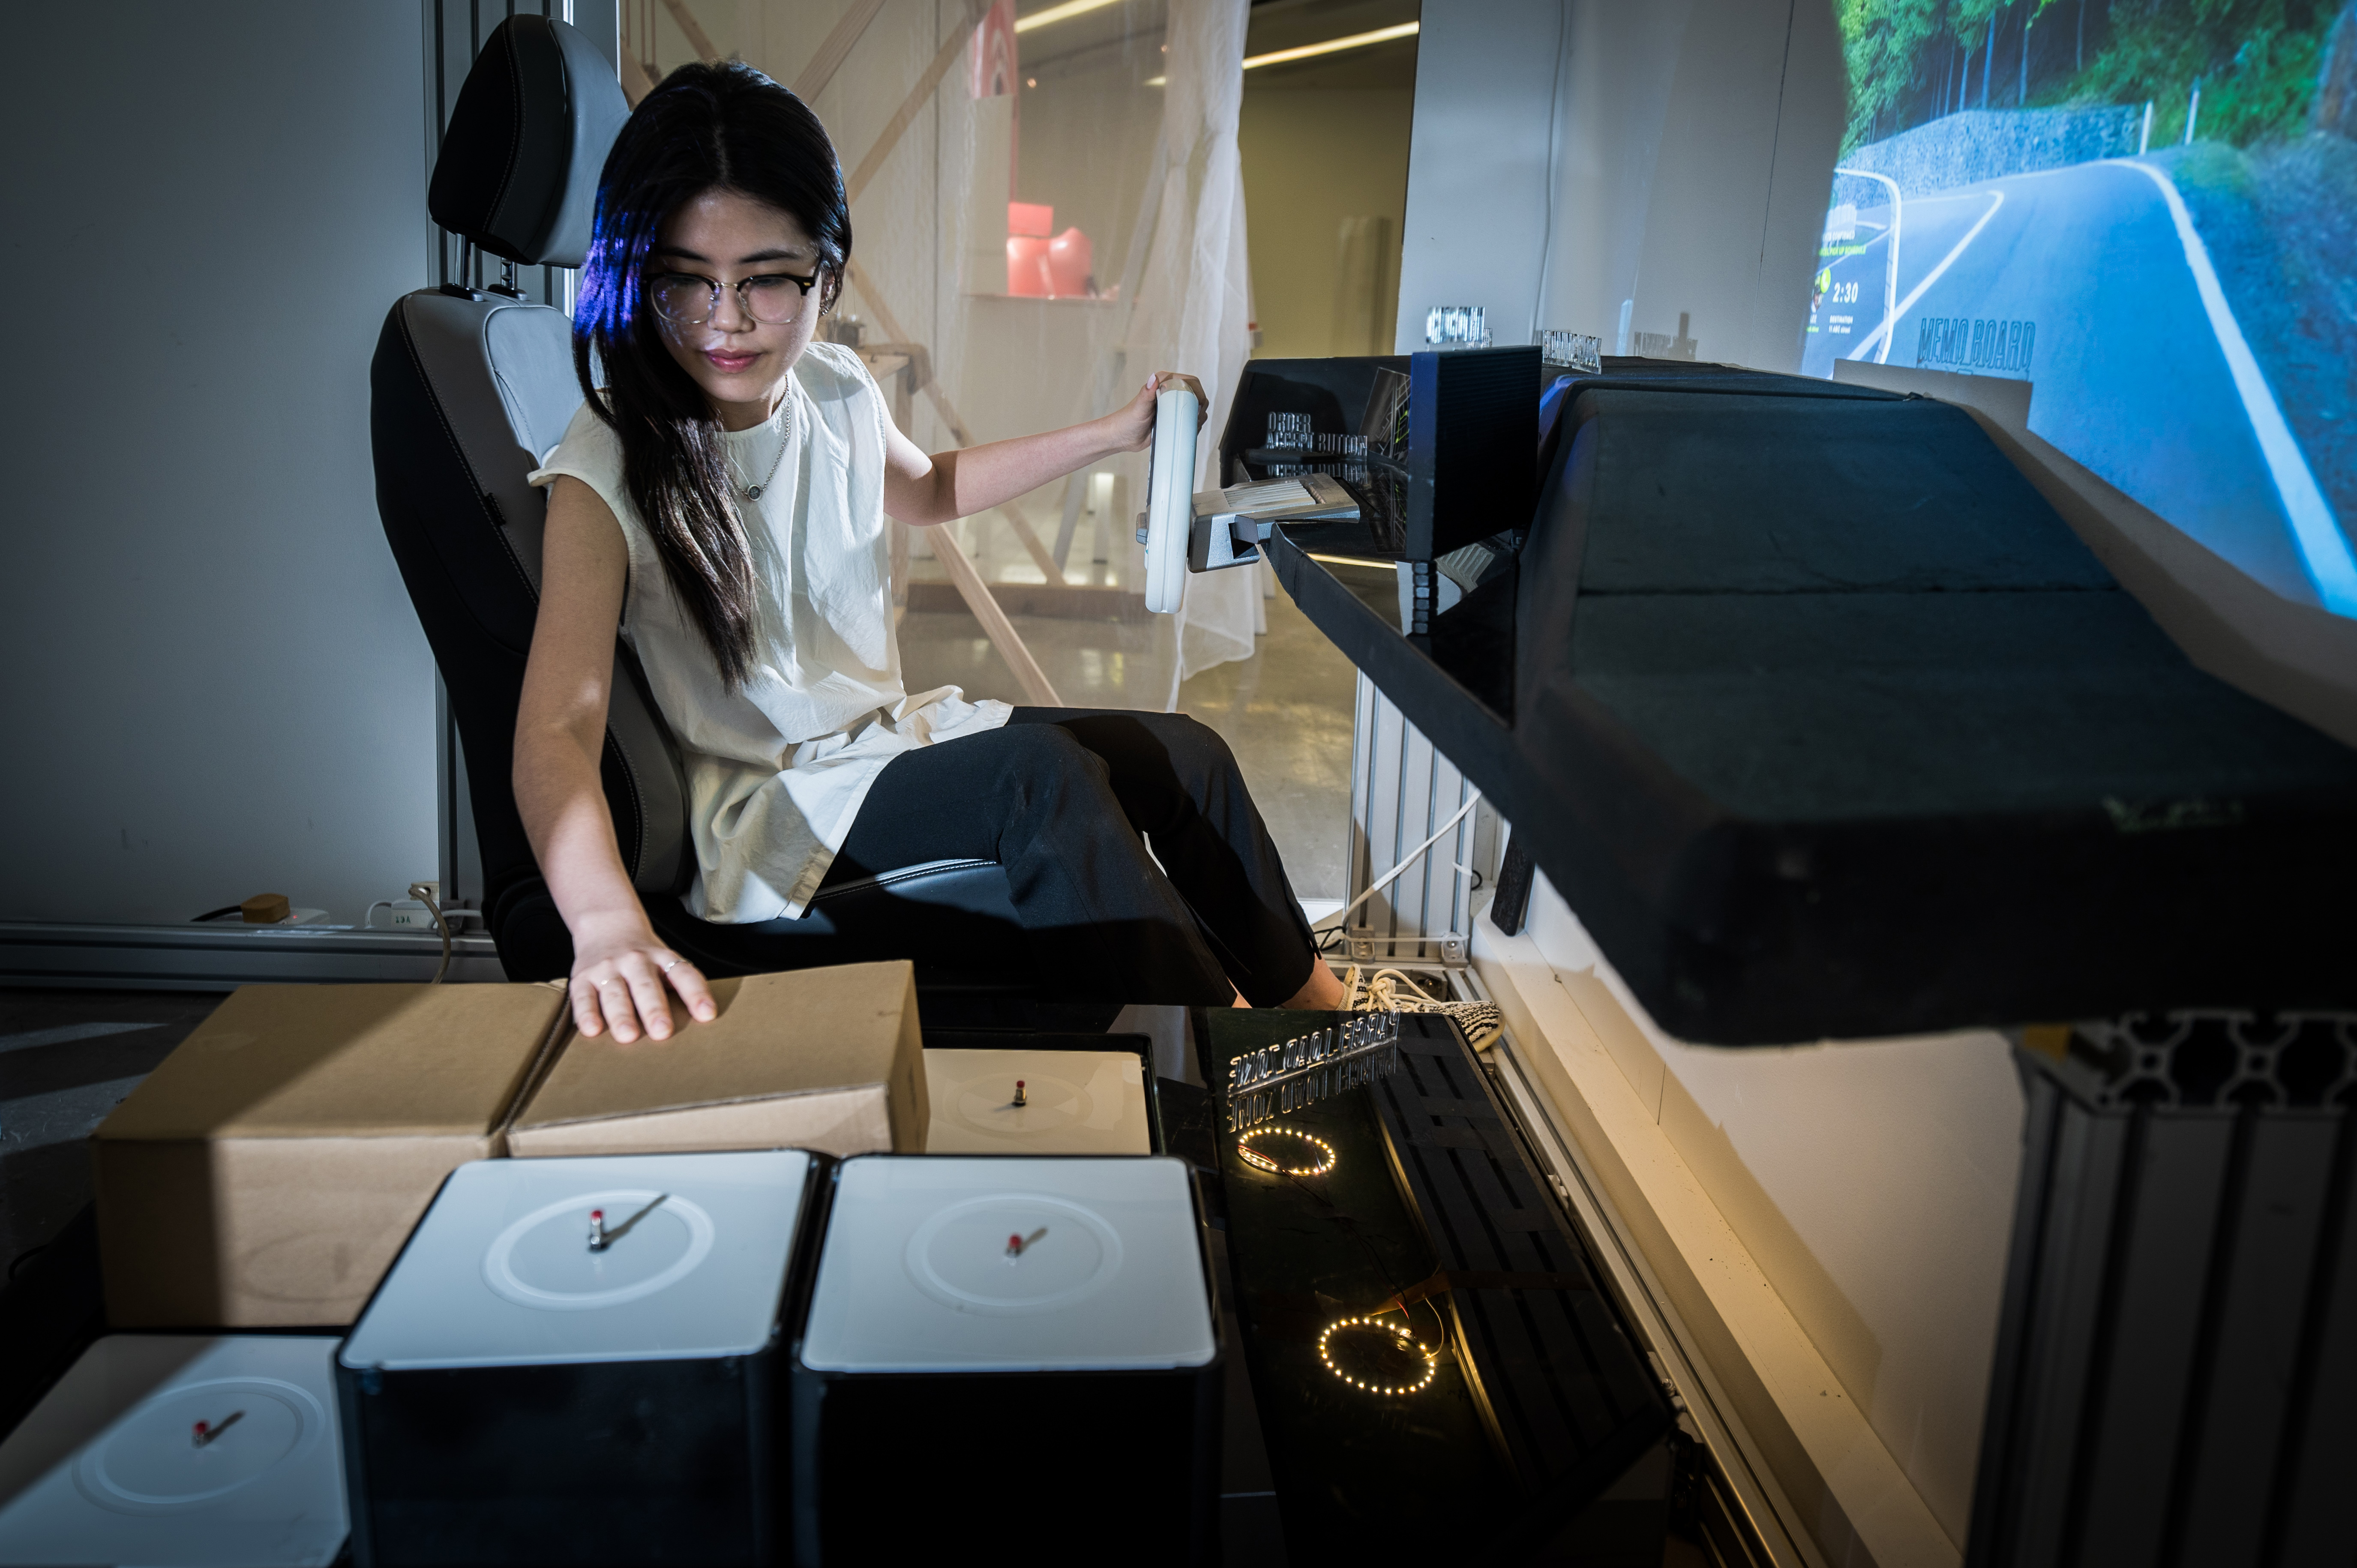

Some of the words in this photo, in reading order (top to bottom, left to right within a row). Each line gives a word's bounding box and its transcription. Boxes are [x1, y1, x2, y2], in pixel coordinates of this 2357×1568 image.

[1832, 282, 1859, 303] 2:30
[1918, 318, 1970, 364] MEMO
[1972, 319, 2036, 372] BOARD
[1268, 411, 1311, 433] ORDER
[1267, 432, 1314, 452] ACCEPT
[1318, 432, 1368, 456] BUTTON
